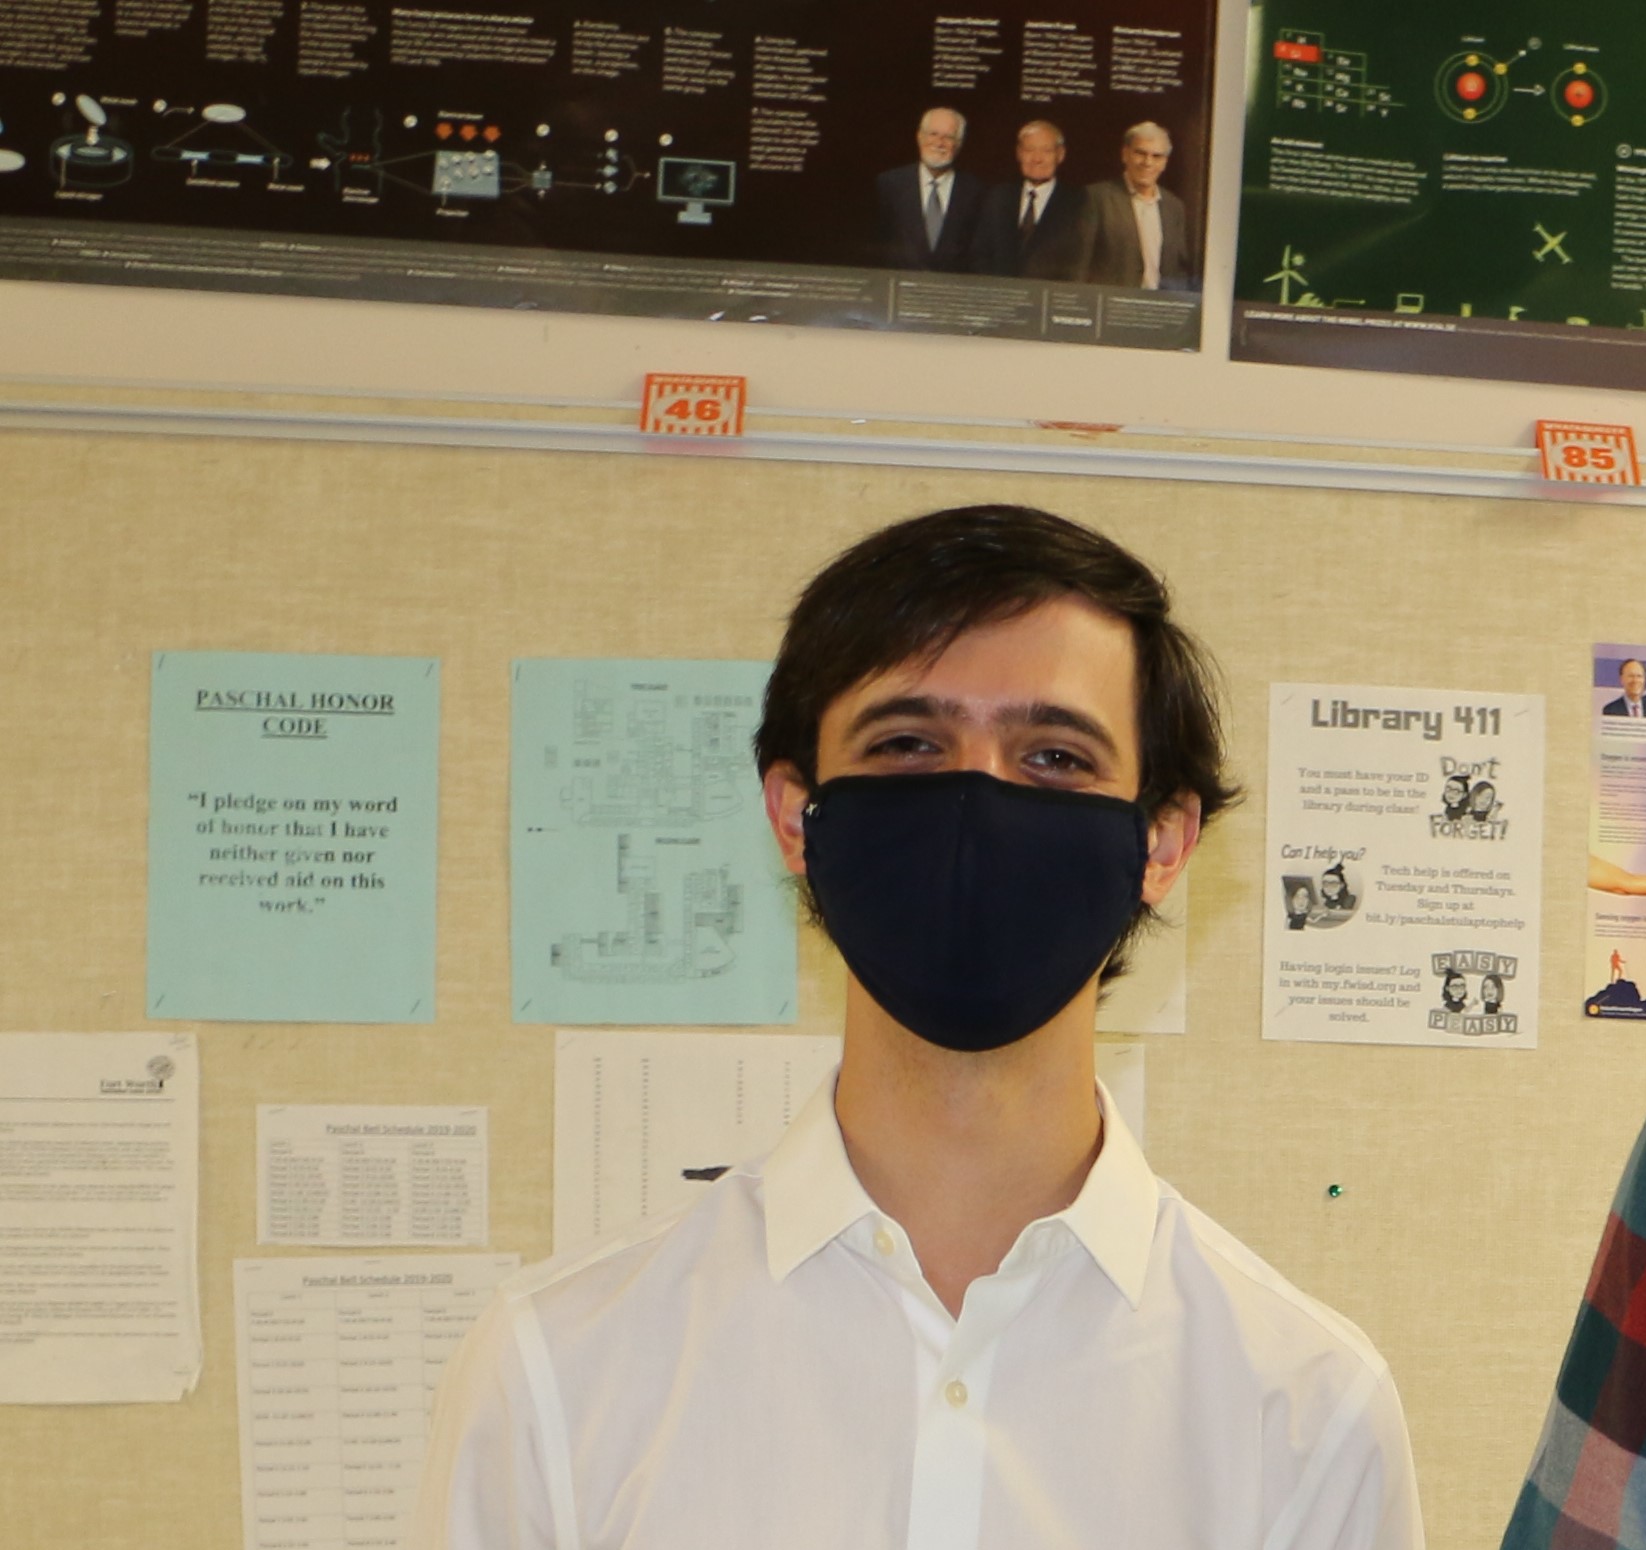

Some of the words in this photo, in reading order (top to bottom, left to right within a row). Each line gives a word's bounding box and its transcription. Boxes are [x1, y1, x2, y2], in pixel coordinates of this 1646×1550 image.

[664, 399, 722, 421] 46
[1562, 446, 1616, 470] 85
[196, 689, 303, 711] PASCHAL
[311, 692, 394, 712] HONOR
[262, 717, 328, 736] CODE
[1311, 699, 1442, 741] Library
[1454, 705, 1502, 735] 411
[1298, 767, 1320, 779] You
[1323, 769, 1351, 780] must
[1355, 770, 1383, 781] have
[1386, 773, 1413, 784] your
[1415, 772, 1430, 783] ID
[1300, 784, 1321, 795] and
[1323, 787, 1331, 796] a
[1333, 787, 1360, 798] pass
[1363, 786, 1375, 797] to
[1378, 786, 1391, 797] be
[1393, 787, 1405, 798] in
[1407, 788, 1427, 799] the
[214, 793, 277, 814] pledge
[283, 799, 306, 812] on
[313, 799, 340, 816] my
[349, 796, 398, 813] word
[1302, 800, 1342, 813] library
[1345, 801, 1384, 815] during
[196, 819, 215, 834] of
[222, 821, 279, 836] honor
[286, 821, 323, 837] that
[330, 822, 338, 837] I
[345, 821, 389, 838] have
[1429, 813, 1510, 841] FORGET!
[209, 844, 278, 862] neither
[285, 848, 336, 866] given
[342, 850, 375, 863] nor
[1281, 843, 1302, 860] Can
[1303, 845, 1312, 860] I
[1313, 845, 1338, 863] help
[1339, 847, 1367, 863] you?
[199, 870, 278, 887] received
[286, 872, 314, 887] aid
[321, 874, 344, 889] on
[351, 873, 385, 890] this
[1381, 864, 1412, 877] Tech
[1413, 865, 1439, 879] help
[1441, 867, 1451, 878] is
[1453, 867, 1494, 880] offered
[1496, 870, 1512, 881] on
[1375, 880, 1426, 896] Tuesday
[1428, 882, 1450, 894] and
[1416, 898, 1443, 911] Sign
[1445, 900, 1460, 912] up
[1461, 900, 1475, 910] at
[1279, 960, 1322, 975] Having
[1324, 962, 1353, 976] login
[1399, 964, 1421, 978] Log
[1434, 951, 1516, 978] EASY
[1278, 976, 1291, 987] in
[1293, 976, 1319, 989] with
[1399, 981, 1421, 993] and
[1288, 994, 1315, 1006] your
[1317, 993, 1354, 1006] issues
[1356, 995, 1394, 1008] should
[1397, 997, 1410, 1008] be
